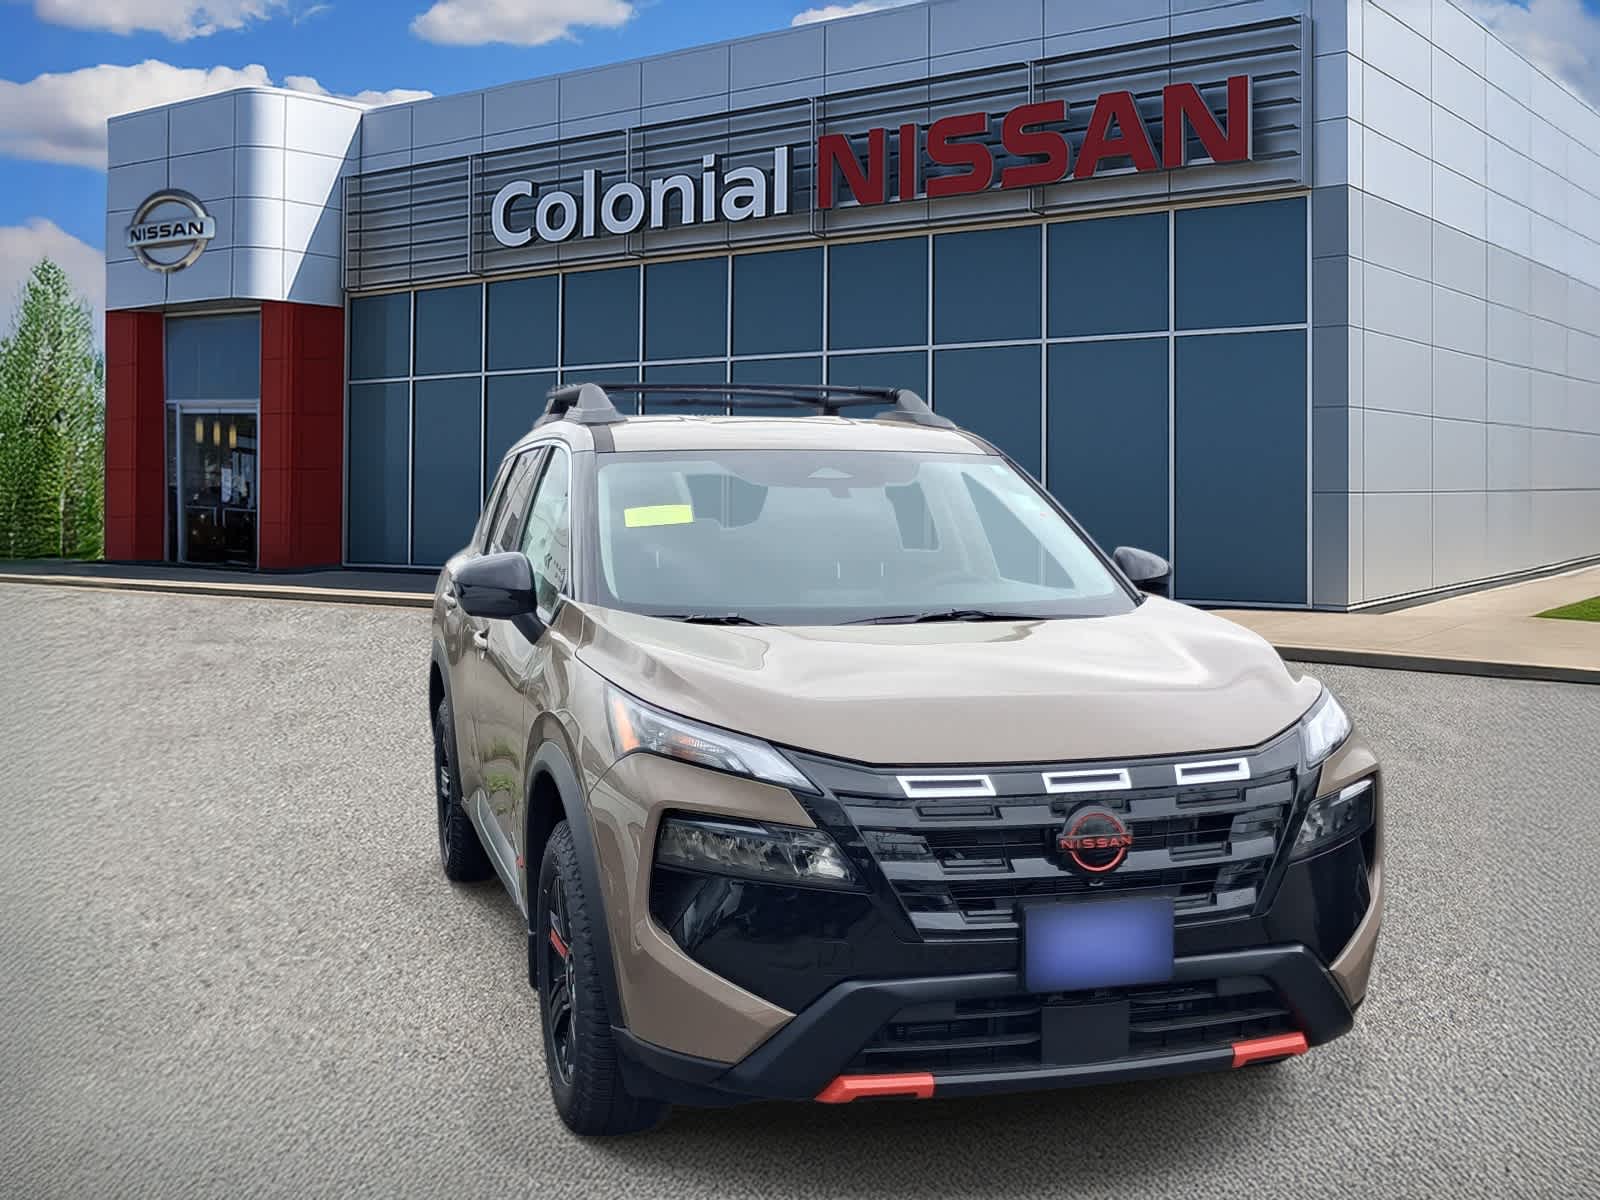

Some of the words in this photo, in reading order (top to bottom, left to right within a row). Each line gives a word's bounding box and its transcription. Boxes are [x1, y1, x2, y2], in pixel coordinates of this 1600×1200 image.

[491, 146, 789, 247] Colonial
[818, 75, 1253, 209] NISSAN
[130, 221, 204, 242] NISSAN
[1060, 834, 1132, 849] NISSAN
